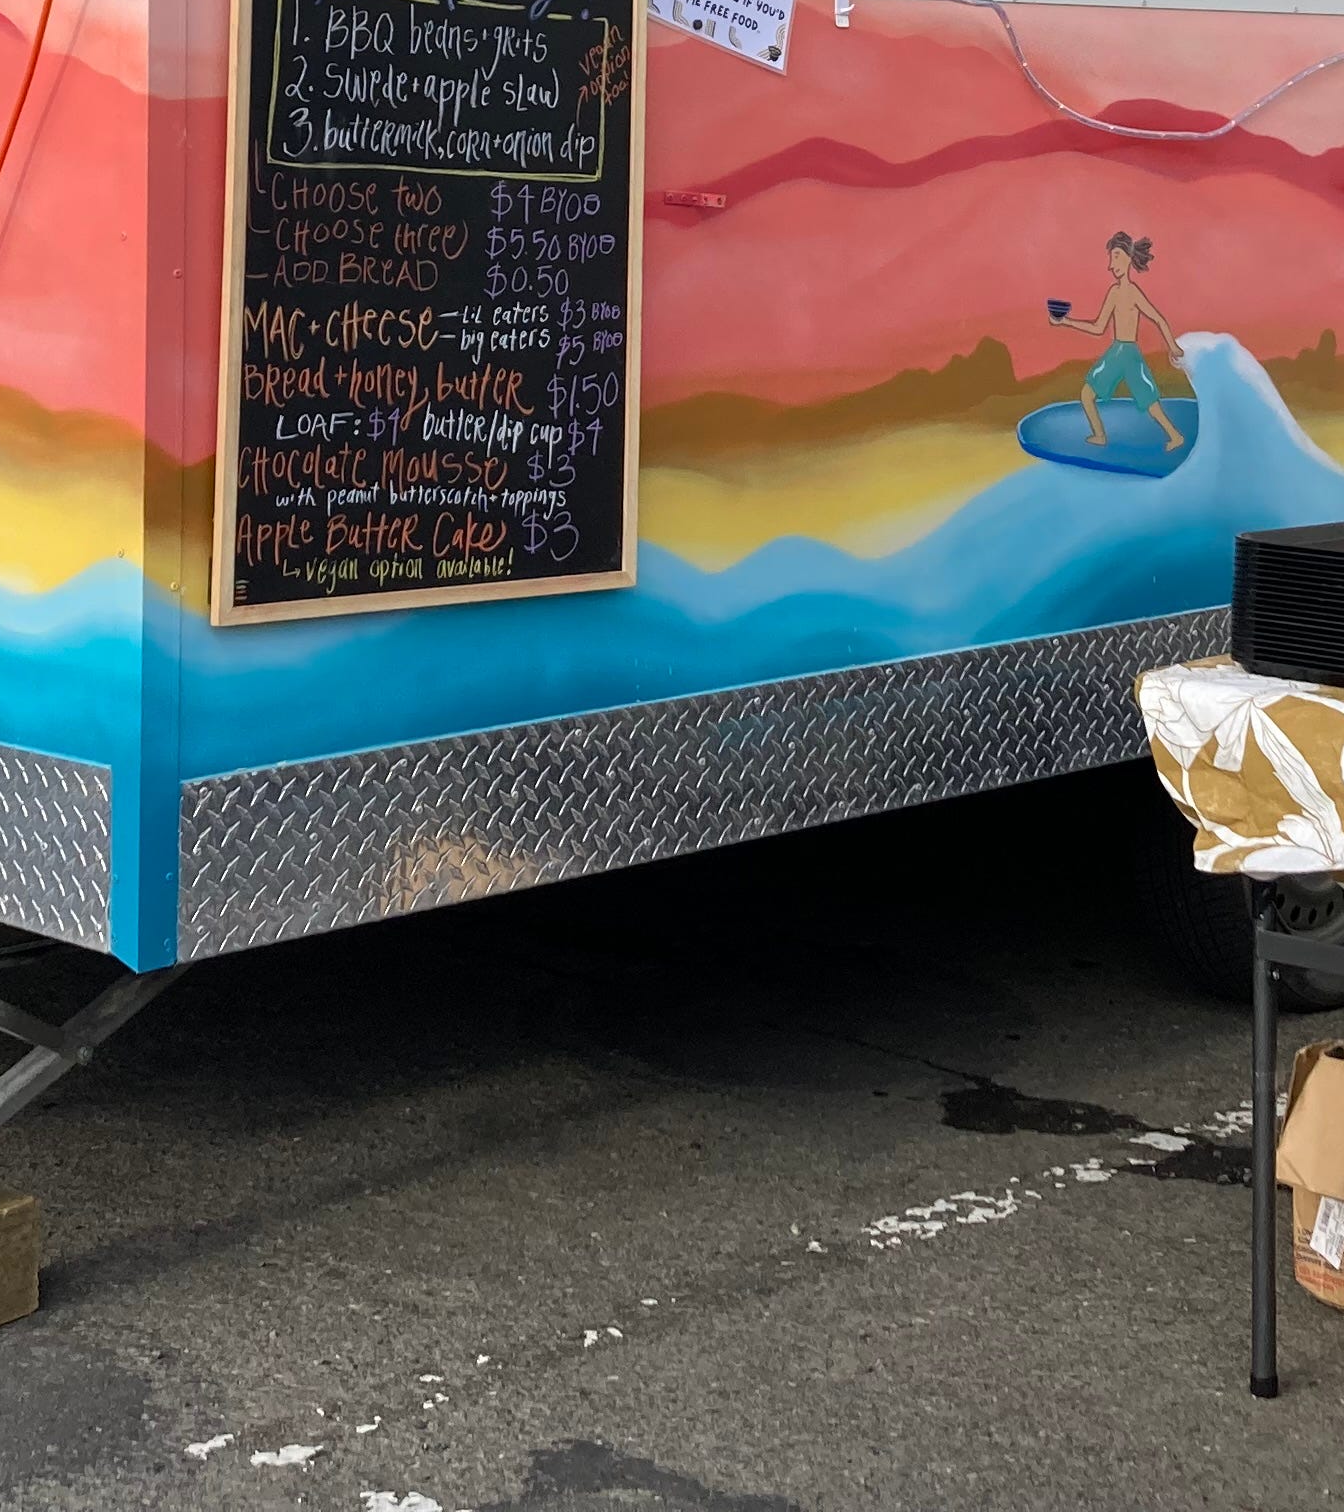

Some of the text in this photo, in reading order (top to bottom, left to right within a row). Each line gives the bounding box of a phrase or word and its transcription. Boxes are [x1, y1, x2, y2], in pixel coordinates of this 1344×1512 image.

[325, 5, 395, 60] BBQ
[704, 0, 729, 19] FREE
[560, 123, 595, 170] dip
[392, 175, 442, 216] two
[491, 180, 535, 224] $4
[485, 225, 561, 261] $5.50
[484, 262, 569, 300] $0.50
[493, 301, 549, 325] eaters
[557, 297, 586, 331] $3
[460, 329, 485, 364] big
[490, 329, 550, 351] eaters
[547, 372, 620, 419] $1.50
[530, 424, 562, 469] cup
[568, 418, 603, 456] $4
[276, 486, 316, 508] with
[327, 481, 379, 516] peanut
[501, 487, 567, 521] toppings
[433, 511, 507, 562] Cake
[522, 509, 580, 561] $3
[306, 546, 514, 594] vegan option available!
